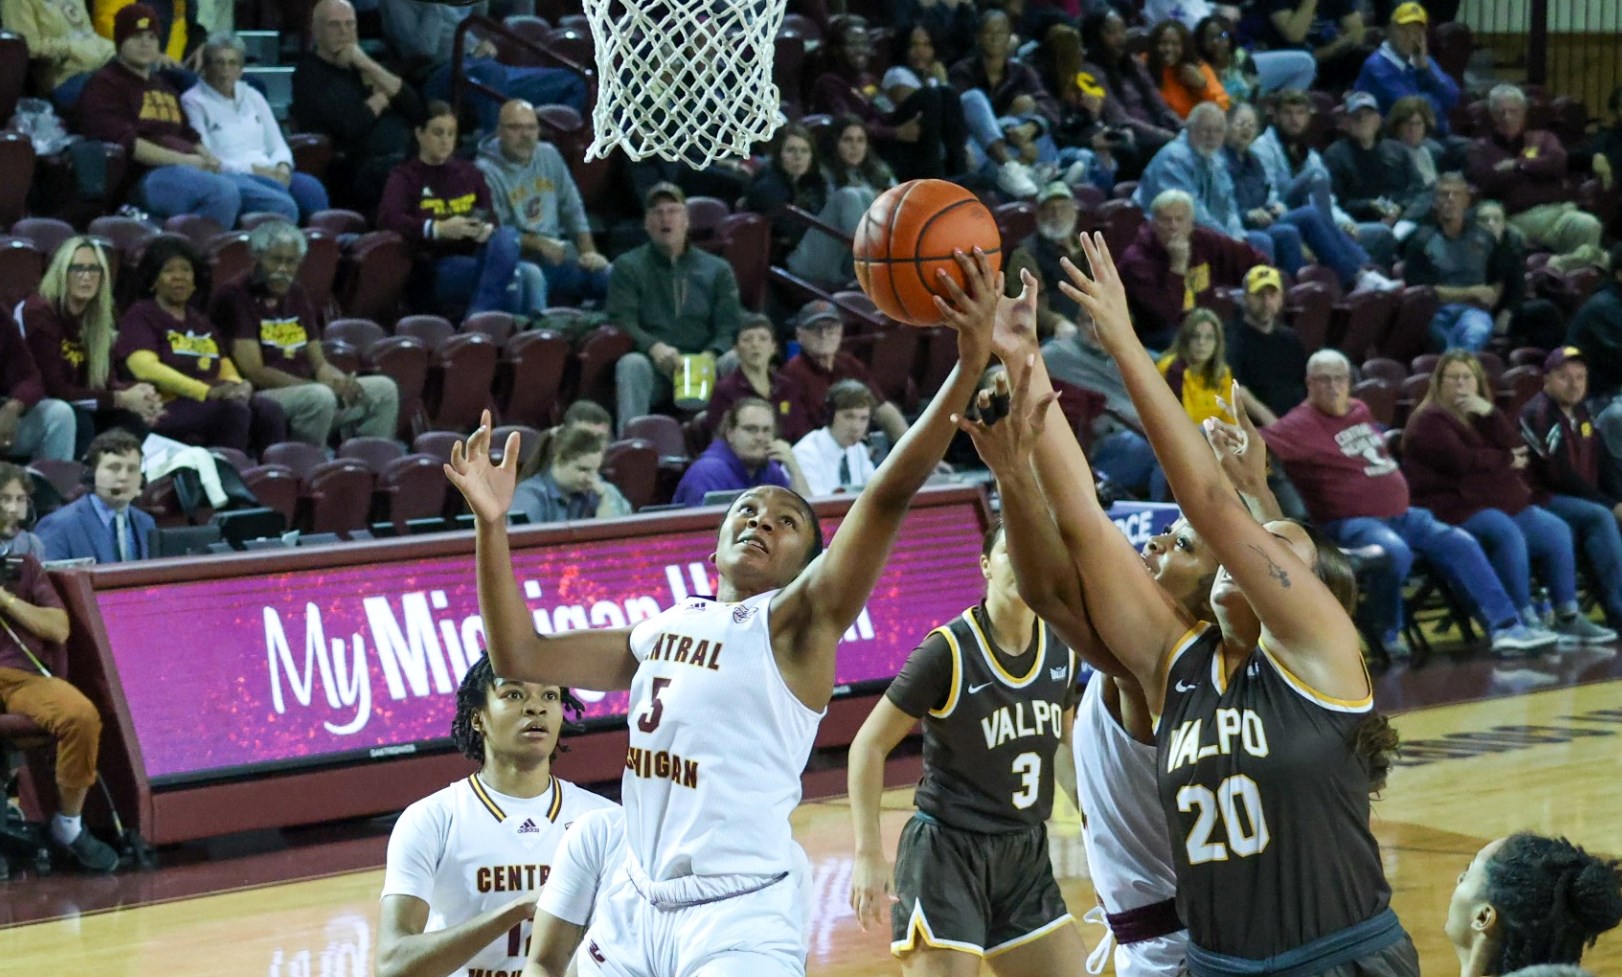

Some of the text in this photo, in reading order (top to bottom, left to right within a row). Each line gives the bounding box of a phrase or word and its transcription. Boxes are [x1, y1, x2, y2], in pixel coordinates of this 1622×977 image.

[645, 632, 723, 670] NTRAL
[637, 677, 672, 733] 5
[980, 700, 1062, 750] VALPO
[1167, 707, 1269, 774] VAPO
[1012, 751, 1041, 810] 3
[1176, 773, 1270, 865] 20
